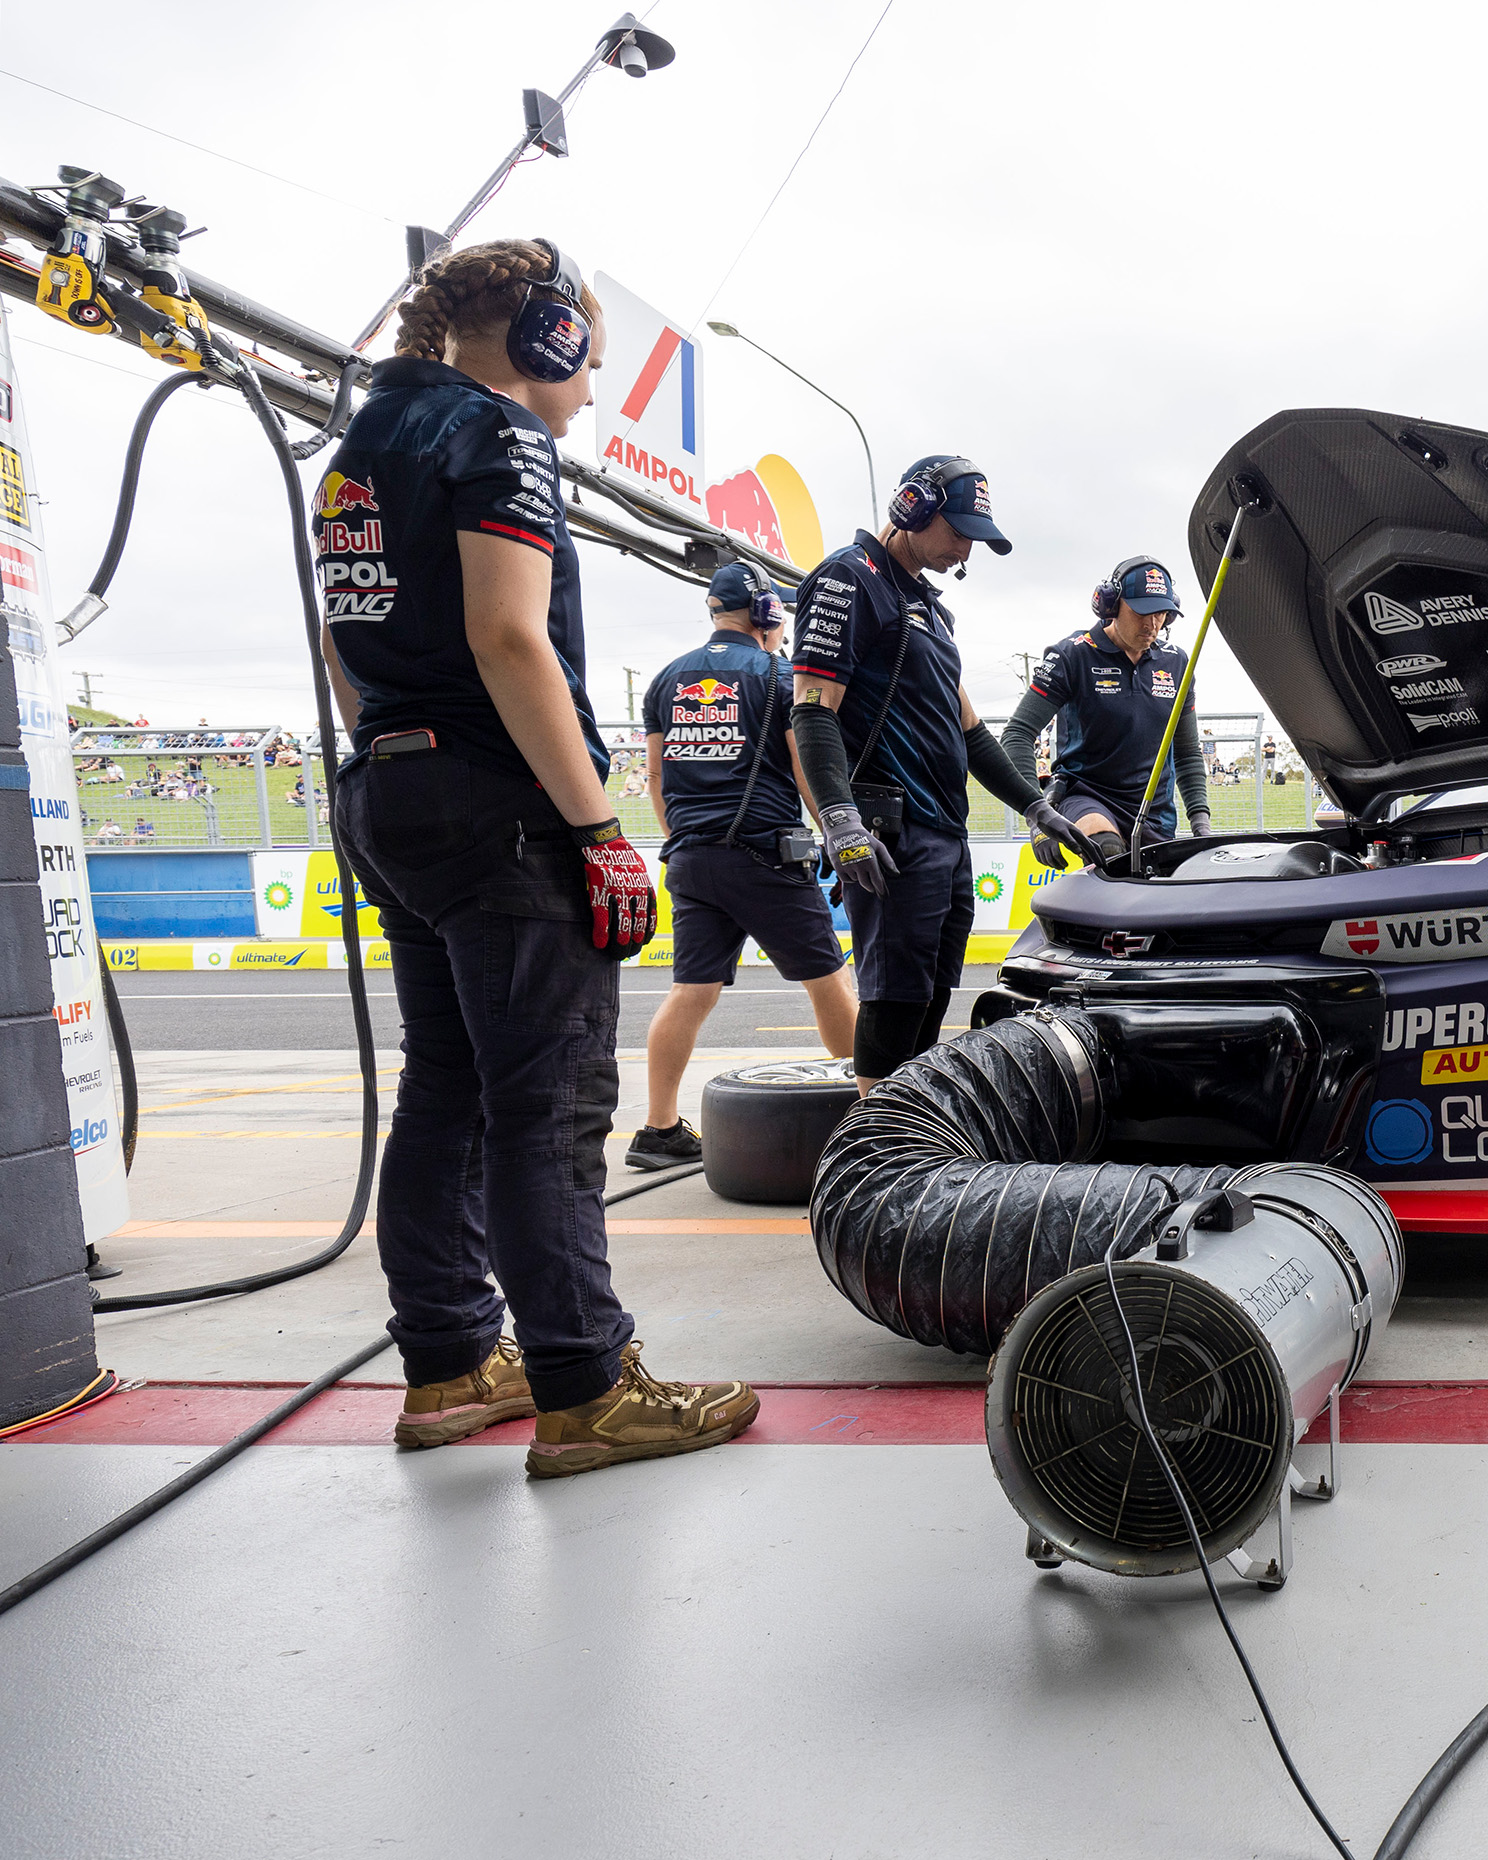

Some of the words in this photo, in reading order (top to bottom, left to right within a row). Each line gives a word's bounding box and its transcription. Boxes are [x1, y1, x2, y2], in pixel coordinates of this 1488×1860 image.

[549, 331, 580, 354] AMPOL
[603, 435, 701, 505] AMPOL
[331, 520, 383, 554] Bull
[318, 561, 398, 588] POL
[325, 592, 395, 618] CING
[1419, 594, 1474, 613] AVERY
[1382, 657, 1427, 678] PWR
[1390, 677, 1464, 700] SolidCAM
[672, 705, 705, 724] Red
[707, 704, 739, 723] Bull
[1438, 707, 1478, 728] paoli
[664, 726, 746, 742] AMPOL
[663, 744, 743, 757] RACING
[31, 798, 69, 819] LLAND
[40, 845, 76, 871] RTH
[991, 861, 1004, 870] bp
[281, 869, 293, 879] bp
[44, 898, 81, 927] UAD
[45, 928, 85, 959] OCK
[110, 948, 136, 967] 02
[236, 951, 287, 964] ultimate
[53, 1000, 91, 1026] LIFY
[74, 1029, 93, 1044] Fuels
[65, 1069, 101, 1088] HEVROLET
[70, 1118, 108, 1149] elco
